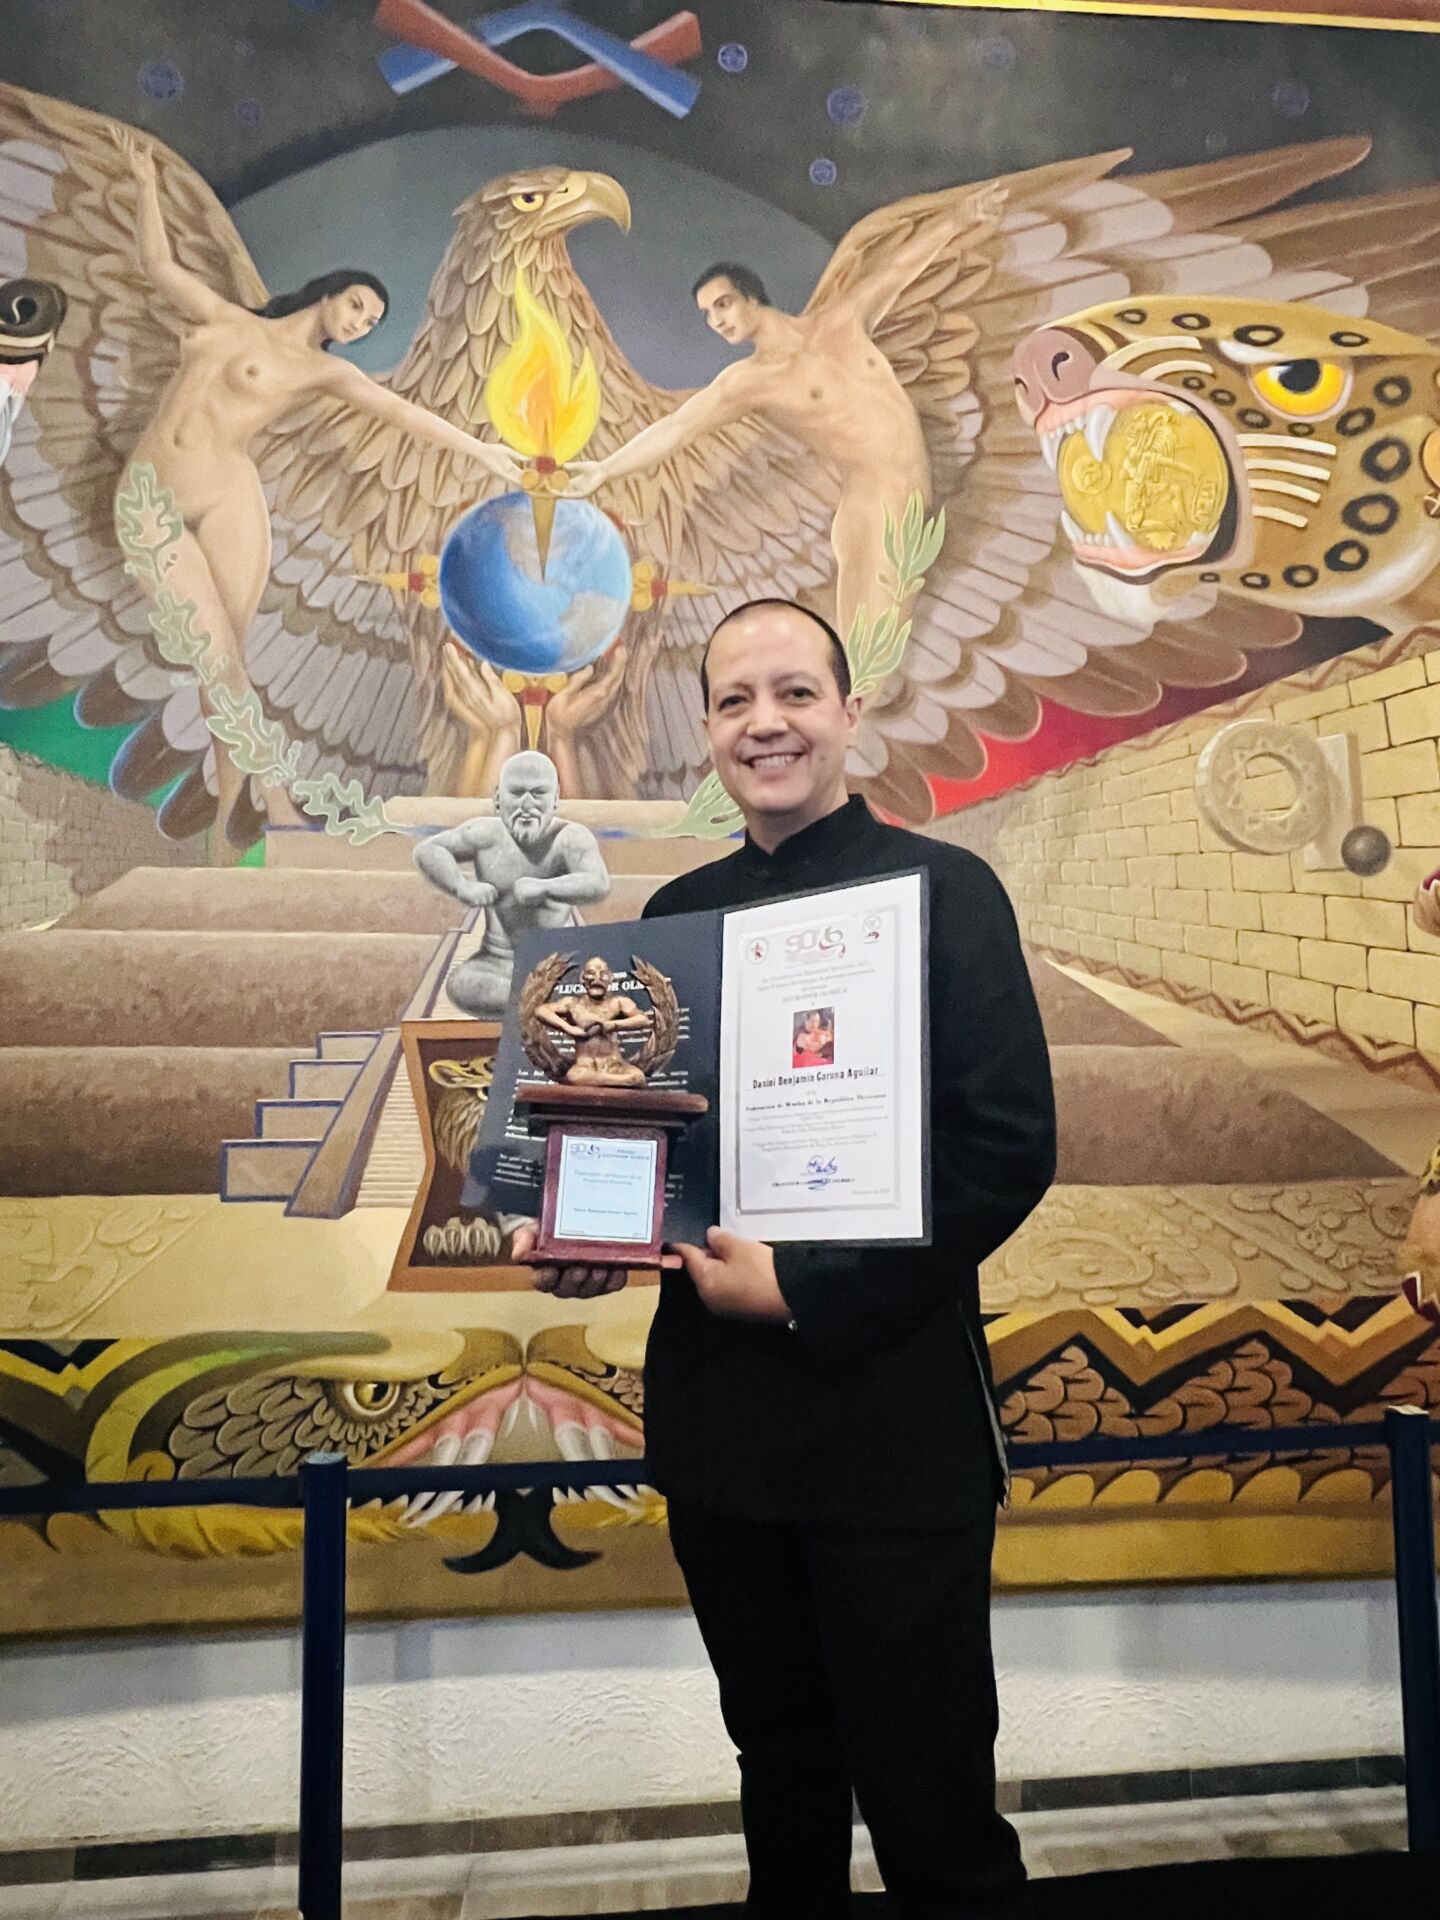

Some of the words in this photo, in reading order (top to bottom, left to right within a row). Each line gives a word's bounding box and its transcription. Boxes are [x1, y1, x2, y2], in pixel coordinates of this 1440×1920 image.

[753, 1078, 776, 1089] Daniel
[778, 1073, 815, 1087] Benjamin
[816, 1071, 845, 1081] Corona
[847, 1067, 878, 1080] Aguilar
